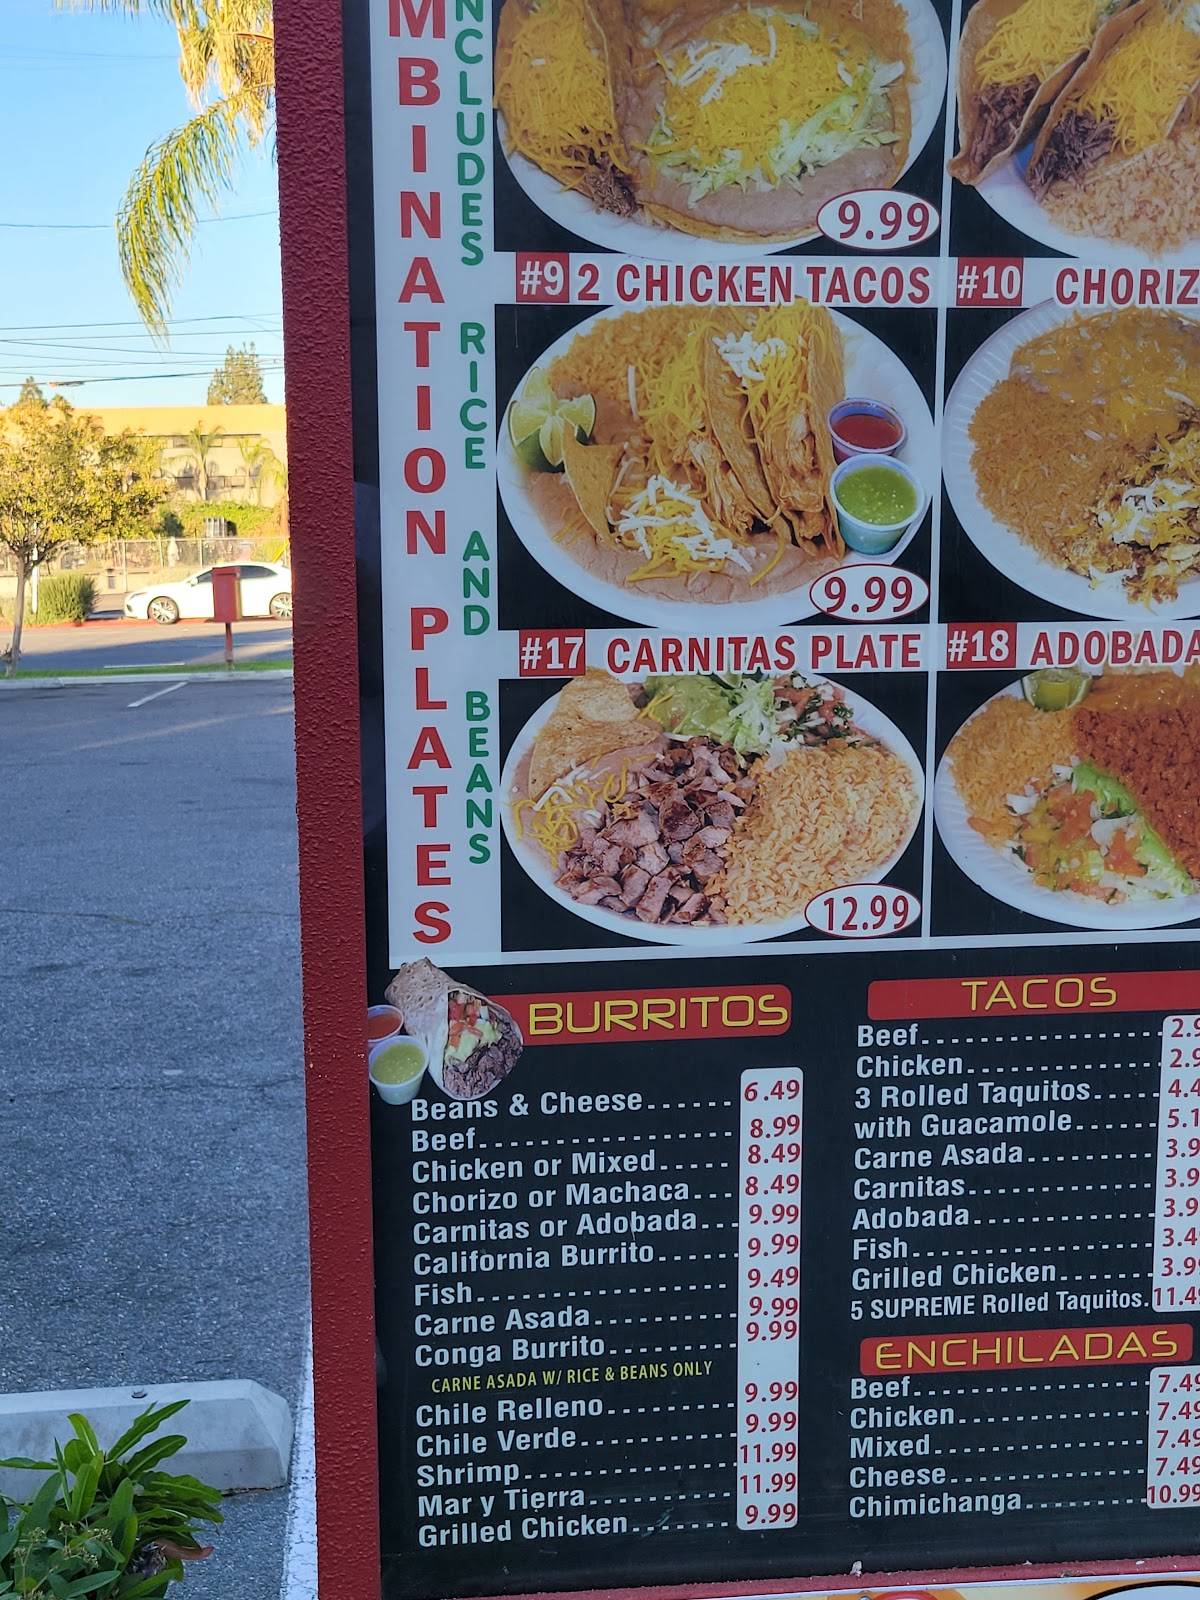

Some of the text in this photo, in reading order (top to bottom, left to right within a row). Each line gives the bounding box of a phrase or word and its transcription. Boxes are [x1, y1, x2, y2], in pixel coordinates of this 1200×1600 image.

[838, 200, 930, 241] 9.99
[520, 260, 930, 304] #9 2 CHICKEN TACOS
[958, 265, 1200, 305] #10 CHORIZ
[454, 0, 493, 865] NCLUDES RICE AND BEANS
[387, 0, 453, 944] MBINATION PLATES
[825, 576, 913, 613] 9.99
[521, 634, 920, 673] #17 CARNITAS PLATE
[949, 630, 1200, 665] #18 ADOBADA
[824, 895, 909, 930] 12.99
[962, 977, 1117, 1011] TACOS
[529, 994, 789, 1036] BURRITOS
[858, 1024, 918, 1047] Beef
[857, 1054, 962, 1078] Chicken
[412, 1079, 800, 1121] Beans & Cheese 6.49
[855, 1087, 870, 1108] 3
[882, 1083, 968, 1107] Rolled
[978, 1080, 1090, 1107] Taquitos
[412, 1115, 800, 1152] Beef 8.99
[854, 1116, 910, 1139] with
[922, 1110, 1071, 1136] Guacamole
[413, 1143, 801, 1183] Chicken or Mixed 8.49
[855, 1148, 931, 1169] Carne
[942, 1142, 1022, 1165] Asada
[413, 1174, 800, 1214] Chorizo or Machaca 8.49
[854, 1176, 964, 1200] Carnitas
[414, 1204, 799, 1244] Carnitas or Adobada 9.99
[852, 1205, 968, 1230] Adobada
[414, 1234, 799, 1275] California Burrito 9.99
[854, 1228, 1200, 1260] Fish 3.4
[415, 1266, 799, 1305] Fish 9.49
[853, 1257, 1200, 1290] Grilled Chicken 3.9
[415, 1296, 798, 1336] Carne Asada 9.99
[851, 1301, 862, 1320] 5
[871, 1295, 975, 1319] SUPREME
[983, 1292, 1048, 1313] Rolled
[1154, 1287, 1200, 1306] 11.4
[416, 1320, 798, 1367] Conga Burrito 9.99
[875, 1330, 1177, 1370] ENCHILADAS
[431, 1360, 713, 1393] CARNE ASADA W/ RICE & BEANS ONLY
[851, 1376, 910, 1399] Beef
[417, 1381, 798, 1426] Chile Relleno 9.99
[851, 1406, 954, 1429] Chicken
[417, 1411, 797, 1457] Chile Verde 9.99
[851, 1434, 929, 1458] Mixed
[417, 1443, 797, 1486] Shrimp 11.99
[850, 1467, 945, 1488] Cheese
[419, 1473, 797, 1517] Mar y Tierra 11.99
[850, 1484, 1200, 1517] Chimichanga 10.99
[419, 1503, 796, 1547] Grilled Chicken 9.99
